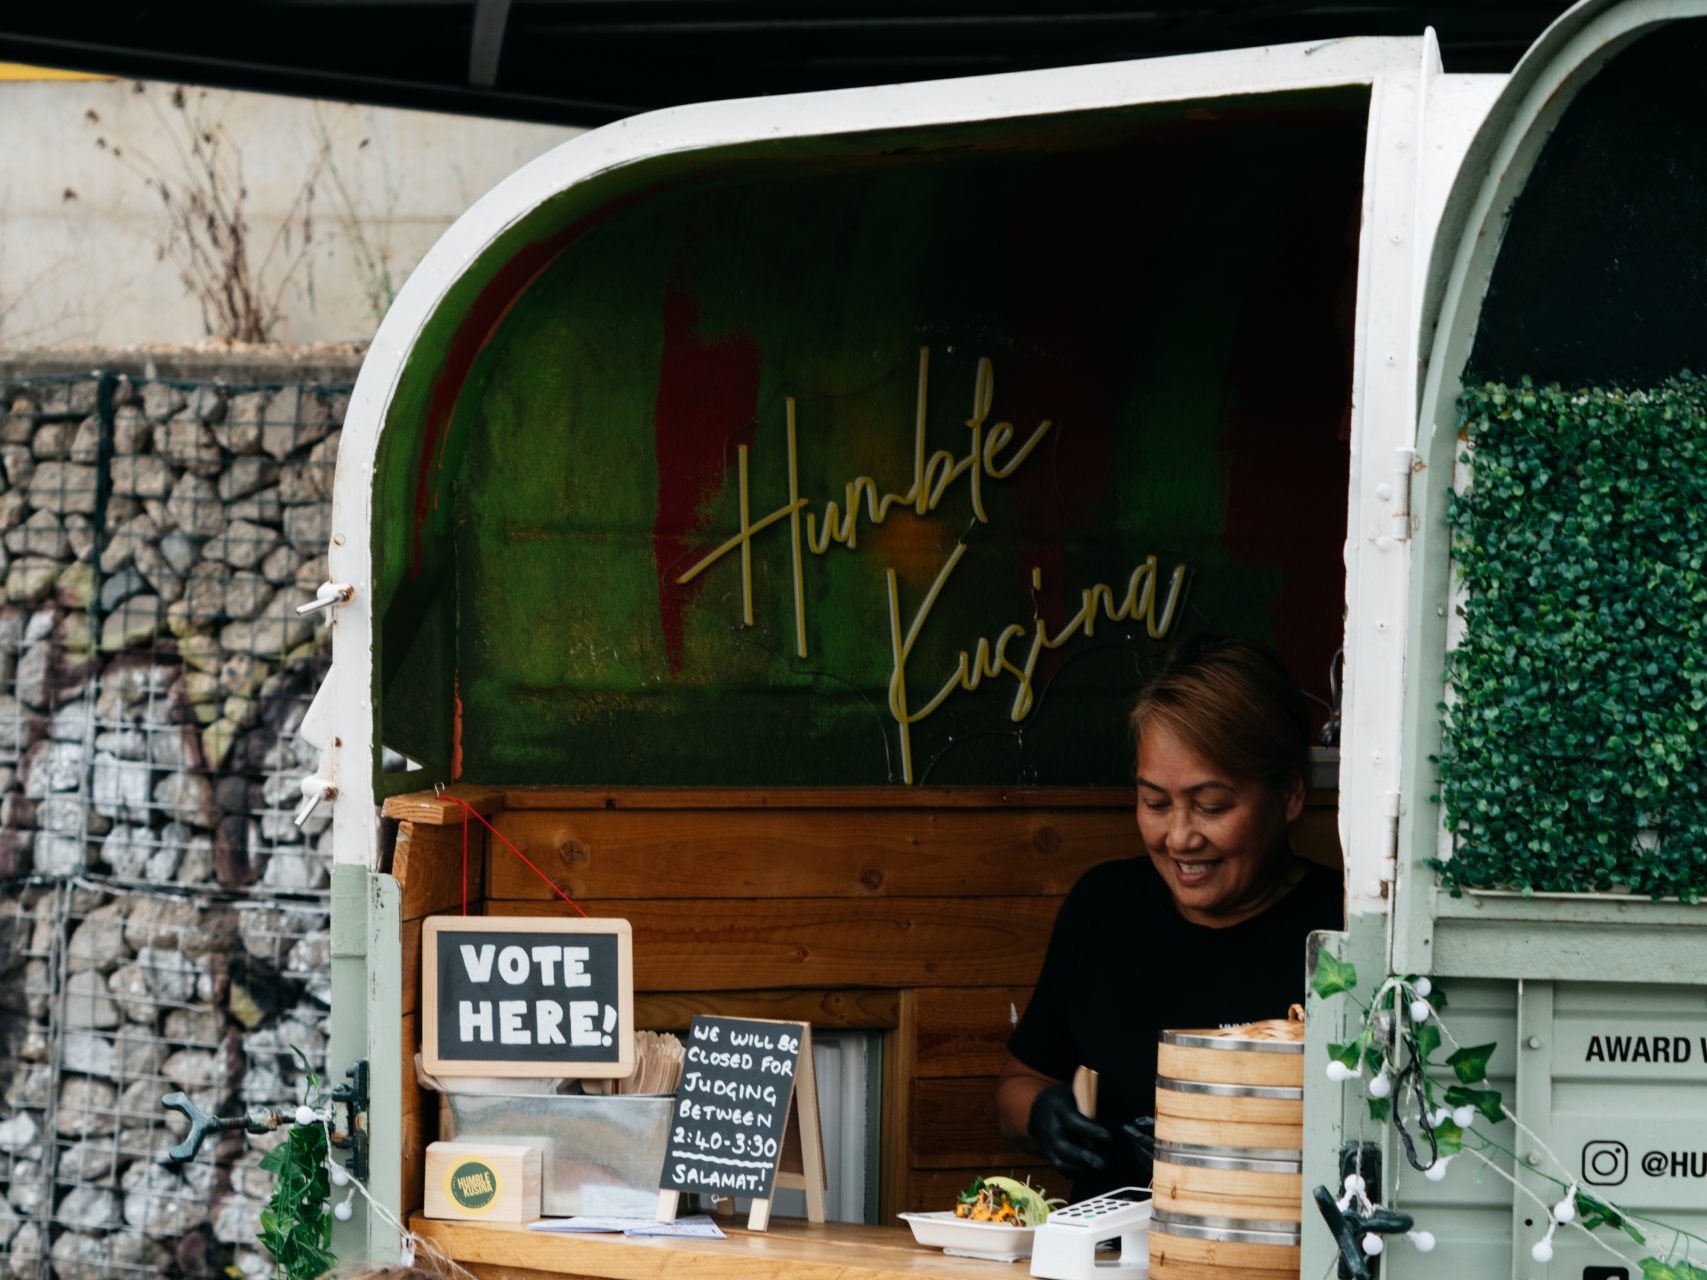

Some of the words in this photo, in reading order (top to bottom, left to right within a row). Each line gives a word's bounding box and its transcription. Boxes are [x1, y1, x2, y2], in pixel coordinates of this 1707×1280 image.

[677, 346, 1051, 658] Humble
[887, 544, 1185, 785] Kusina
[460, 944, 591, 987] VOTE
[459, 1000, 618, 1047] HERE!
[694, 1025, 720, 1042] WE
[730, 1031, 773, 1050] WILL
[777, 1034, 799, 1054] BE
[1585, 1036, 1691, 1063] AWARD
[688, 1046, 752, 1070] CLOSED
[761, 1056, 793, 1077] FOR
[685, 1072, 776, 1107] JUDGING
[679, 1099, 772, 1128] BETWEEN
[673, 1127, 777, 1158] 2:40-3:30
[457, 1171, 491, 1189] HUMBLE
[463, 1180, 493, 1198] KUSINA
[672, 1164, 766, 1192] SALAMAT!
